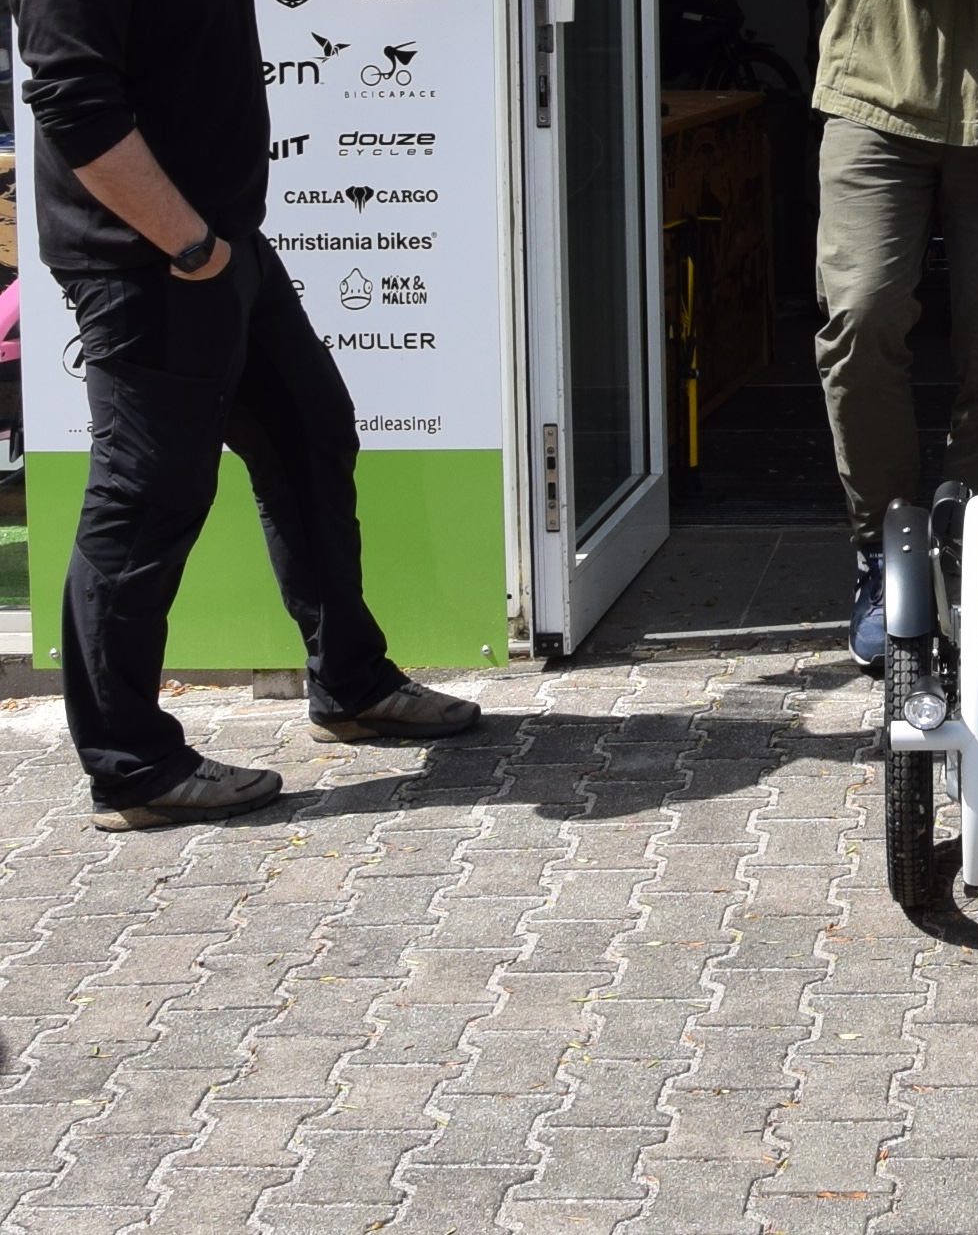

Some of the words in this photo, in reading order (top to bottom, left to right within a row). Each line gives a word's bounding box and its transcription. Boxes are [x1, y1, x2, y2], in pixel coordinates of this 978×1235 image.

[262, 60, 320, 86] ern
[344, 90, 436, 99] BICICAPACE
[338, 130, 436, 146] douze
[267, 134, 310, 162] NIT
[283, 190, 346, 204] CARLA
[376, 189, 439, 204] CARGO
[267, 232, 373, 251] christiania
[412, 275, 426, 291] &
[338, 333, 437, 350] MÜLLER
[355, 415, 442, 435] radleasing!
